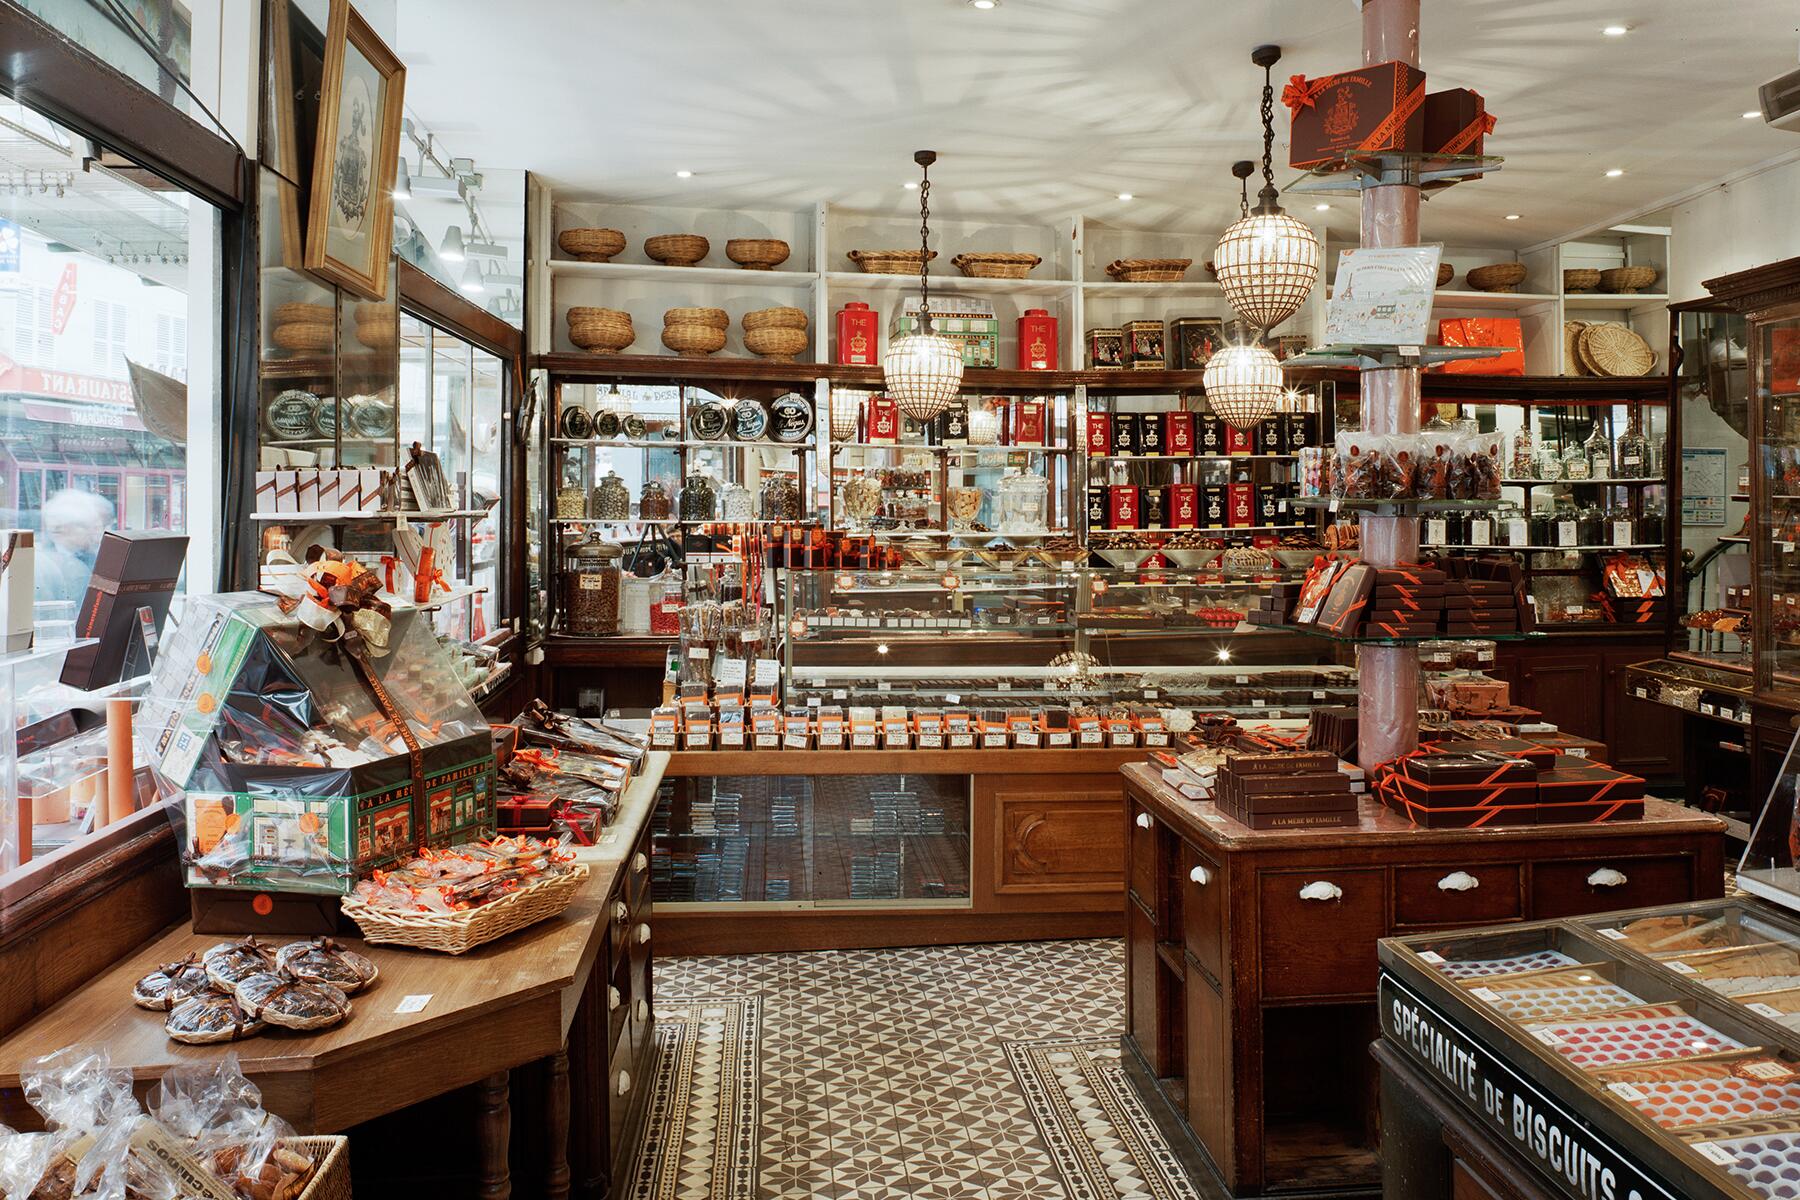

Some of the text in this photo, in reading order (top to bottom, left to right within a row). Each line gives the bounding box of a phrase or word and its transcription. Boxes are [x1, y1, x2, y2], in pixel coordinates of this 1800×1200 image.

[425, 778, 437, 789] DE
[441, 765, 478, 784] FAMILLE
[1315, 815, 1342, 824] FAMILLE
[1392, 999, 1617, 1200] SPÉCIALITÉ DE BISCUITS
